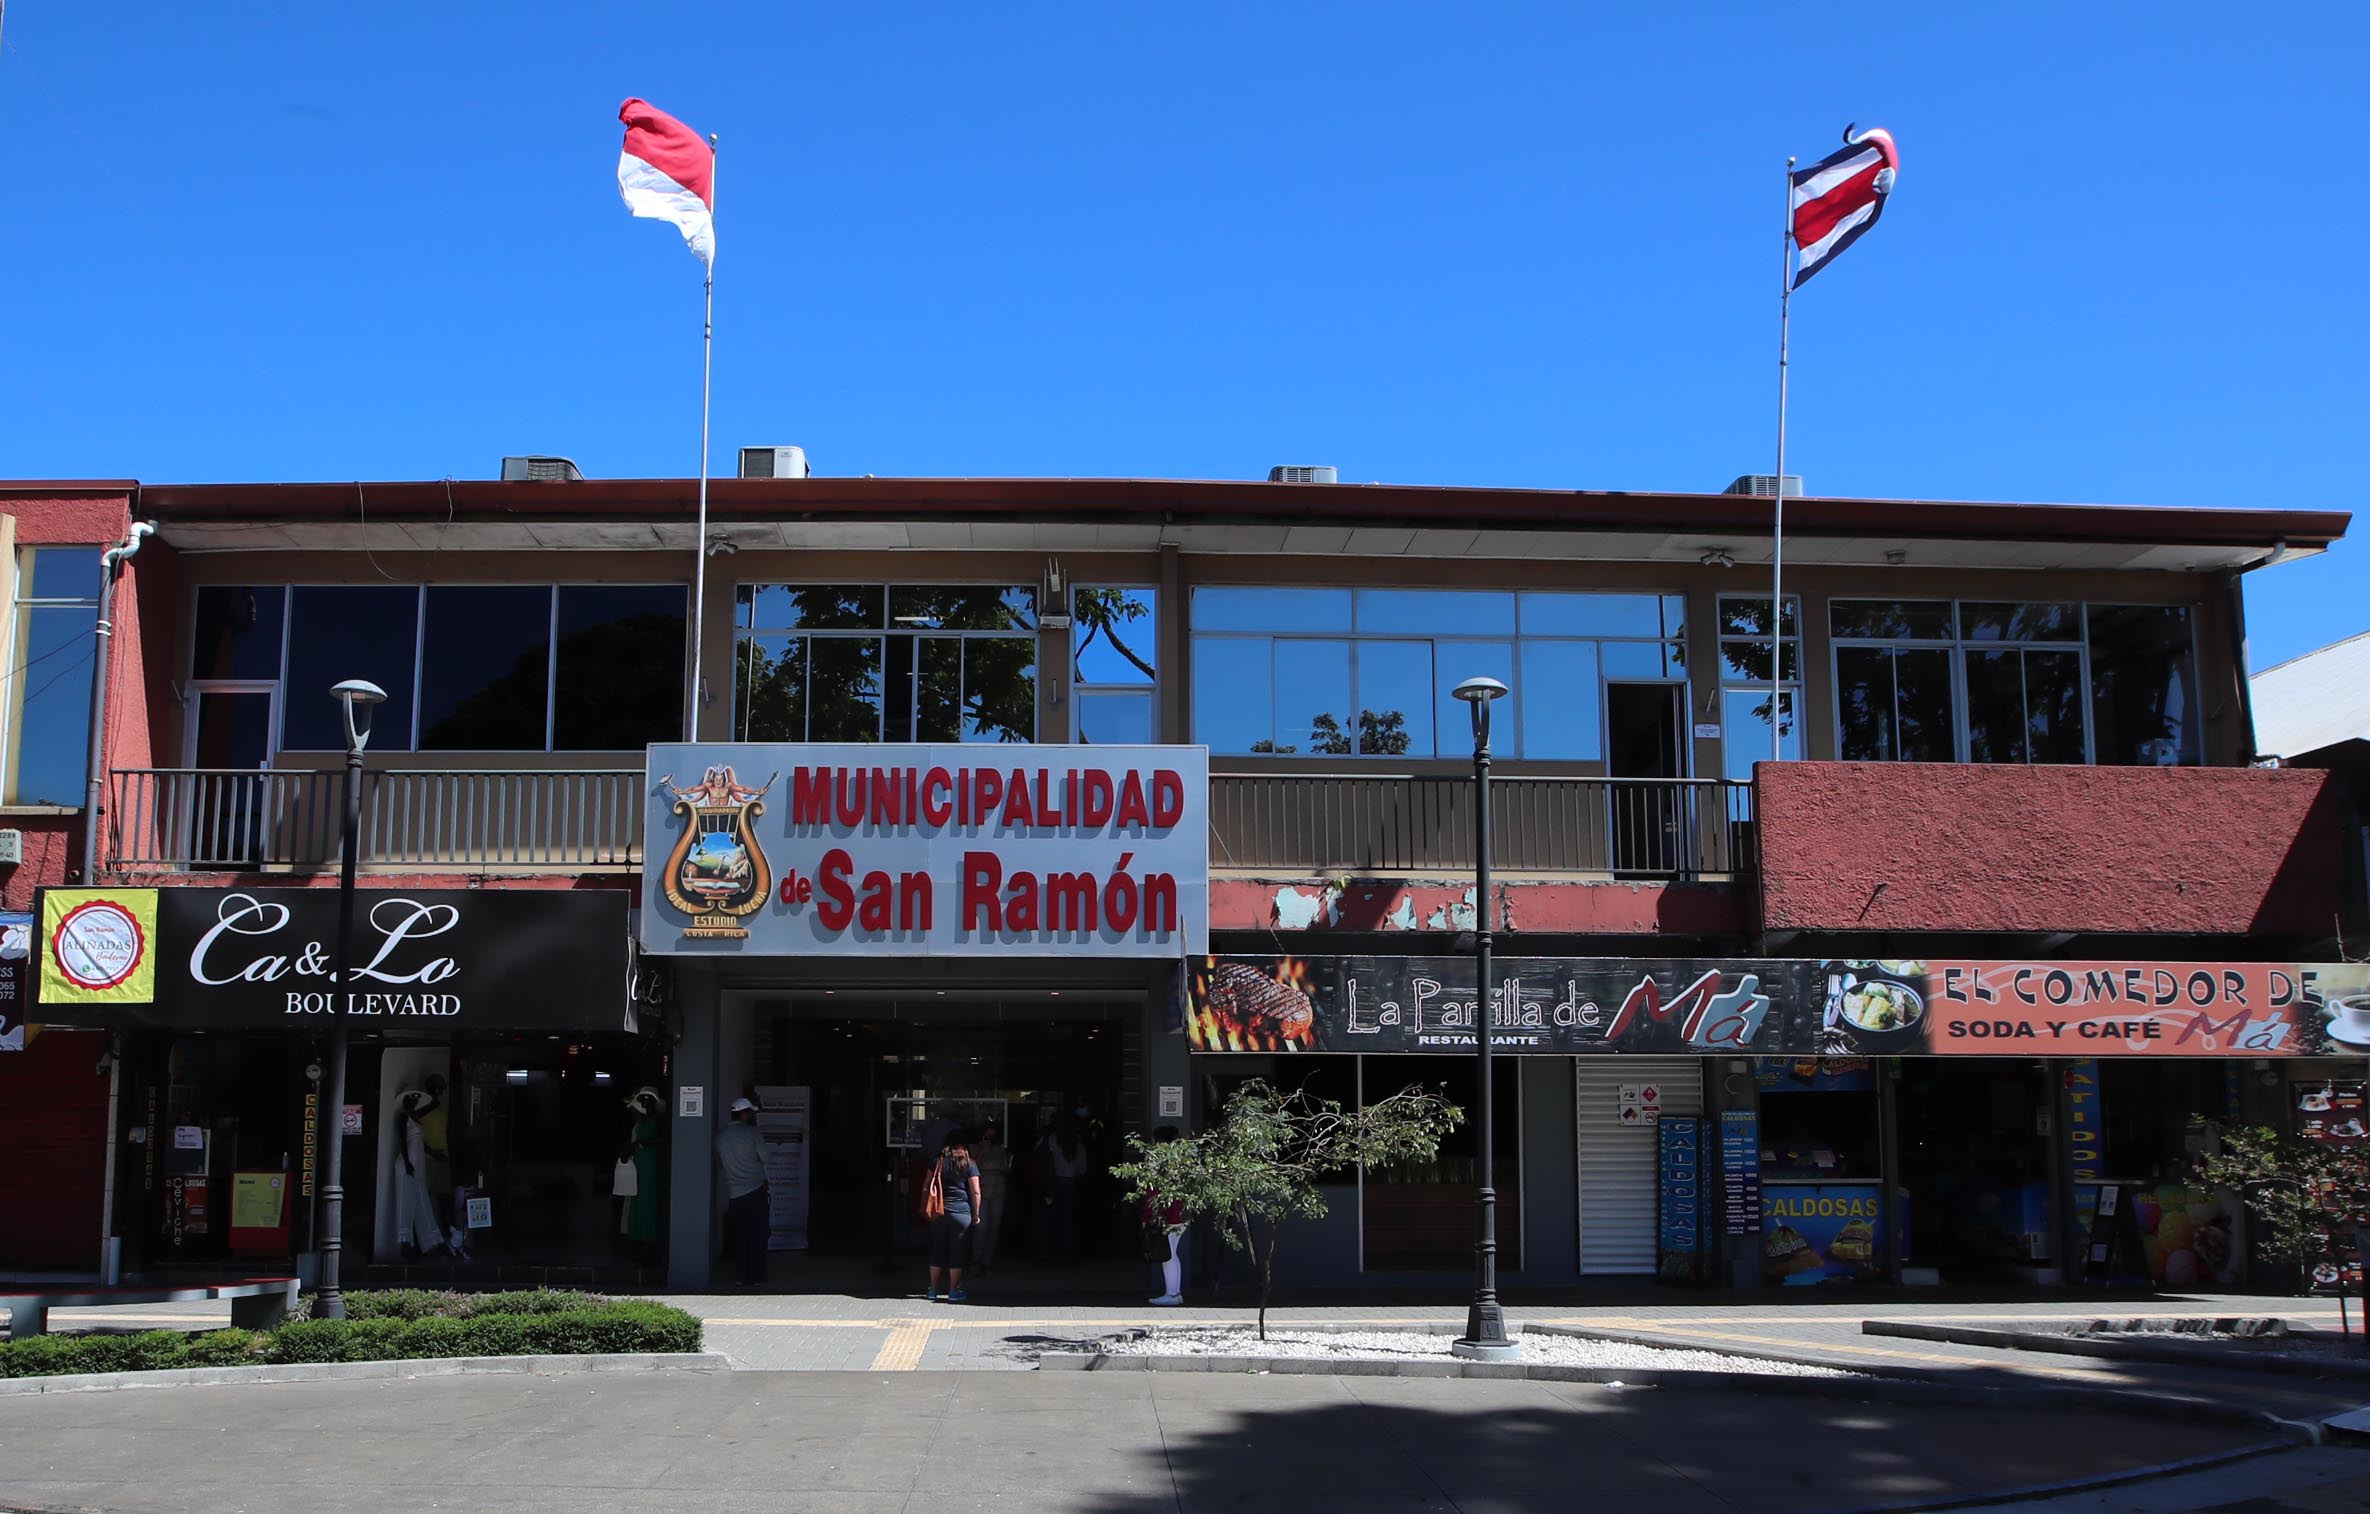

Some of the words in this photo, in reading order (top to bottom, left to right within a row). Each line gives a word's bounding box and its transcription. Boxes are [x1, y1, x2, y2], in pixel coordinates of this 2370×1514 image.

[792, 766, 1184, 828] MUNICIPALIDAD
[666, 889, 693, 914] IDEAL
[738, 890, 767, 915] LUCHA
[780, 868, 812, 904] de
[817, 848, 933, 932] San
[963, 851, 1177, 933] Ramón
[190, 893, 291, 985] Ca
[330, 898, 461, 984] Lo
[694, 915, 737, 927] ESTUDIO
[1347, 978, 1401, 1033] La
[1413, 978, 1543, 1033] Parilla
[1553, 979, 1600, 1026] de
[1944, 968, 1994, 1006] EL
[2012, 969, 2248, 1007] COMEDOR
[2268, 969, 2325, 1008] DE
[1948, 1021, 2035, 1038] SODA
[2046, 1021, 2067, 1038] Y
[2078, 1018, 2162, 1039] CAFÉ
[1667, 1122, 1696, 1247] CALDOSAS
[1762, 1199, 1878, 1217] CALDOSAS
